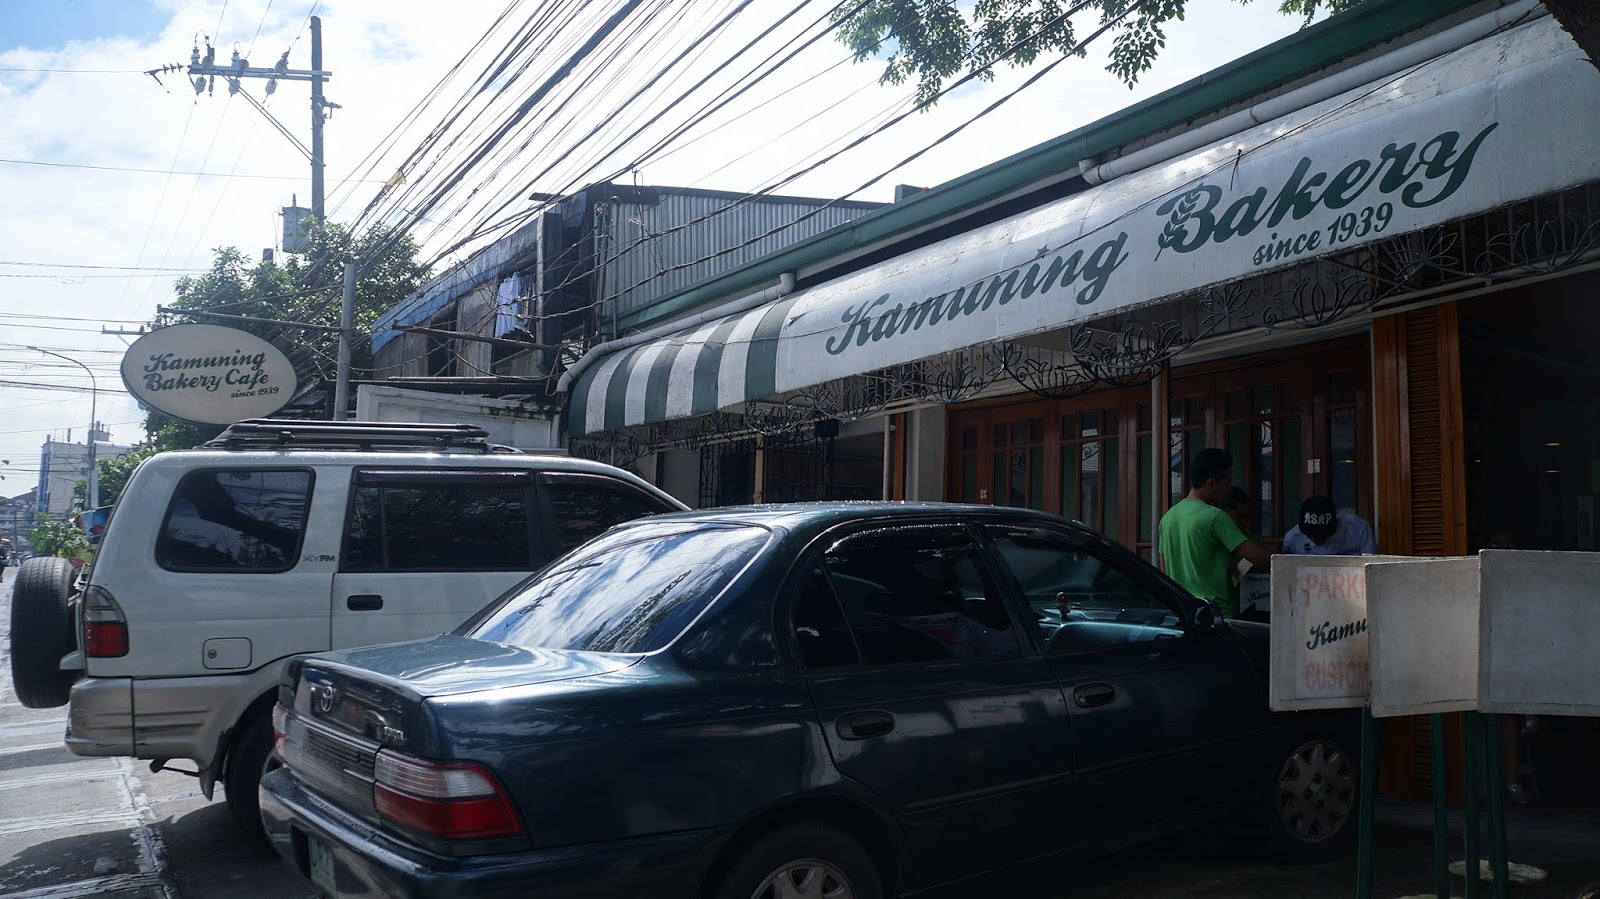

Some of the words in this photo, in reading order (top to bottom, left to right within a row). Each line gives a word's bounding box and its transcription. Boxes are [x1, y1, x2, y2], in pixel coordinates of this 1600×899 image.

[826, 231, 1129, 355] Kamuning
[1155, 122, 1499, 256] Bakery
[1253, 229, 1321, 266] since
[1327, 202, 1394, 245] 1939
[144, 349, 267, 373] Kamuning
[143, 370, 224, 392] Bakery
[225, 368, 269, 390] Cafe
[231, 387, 256, 398] since
[258, 386, 280, 396] 1939
